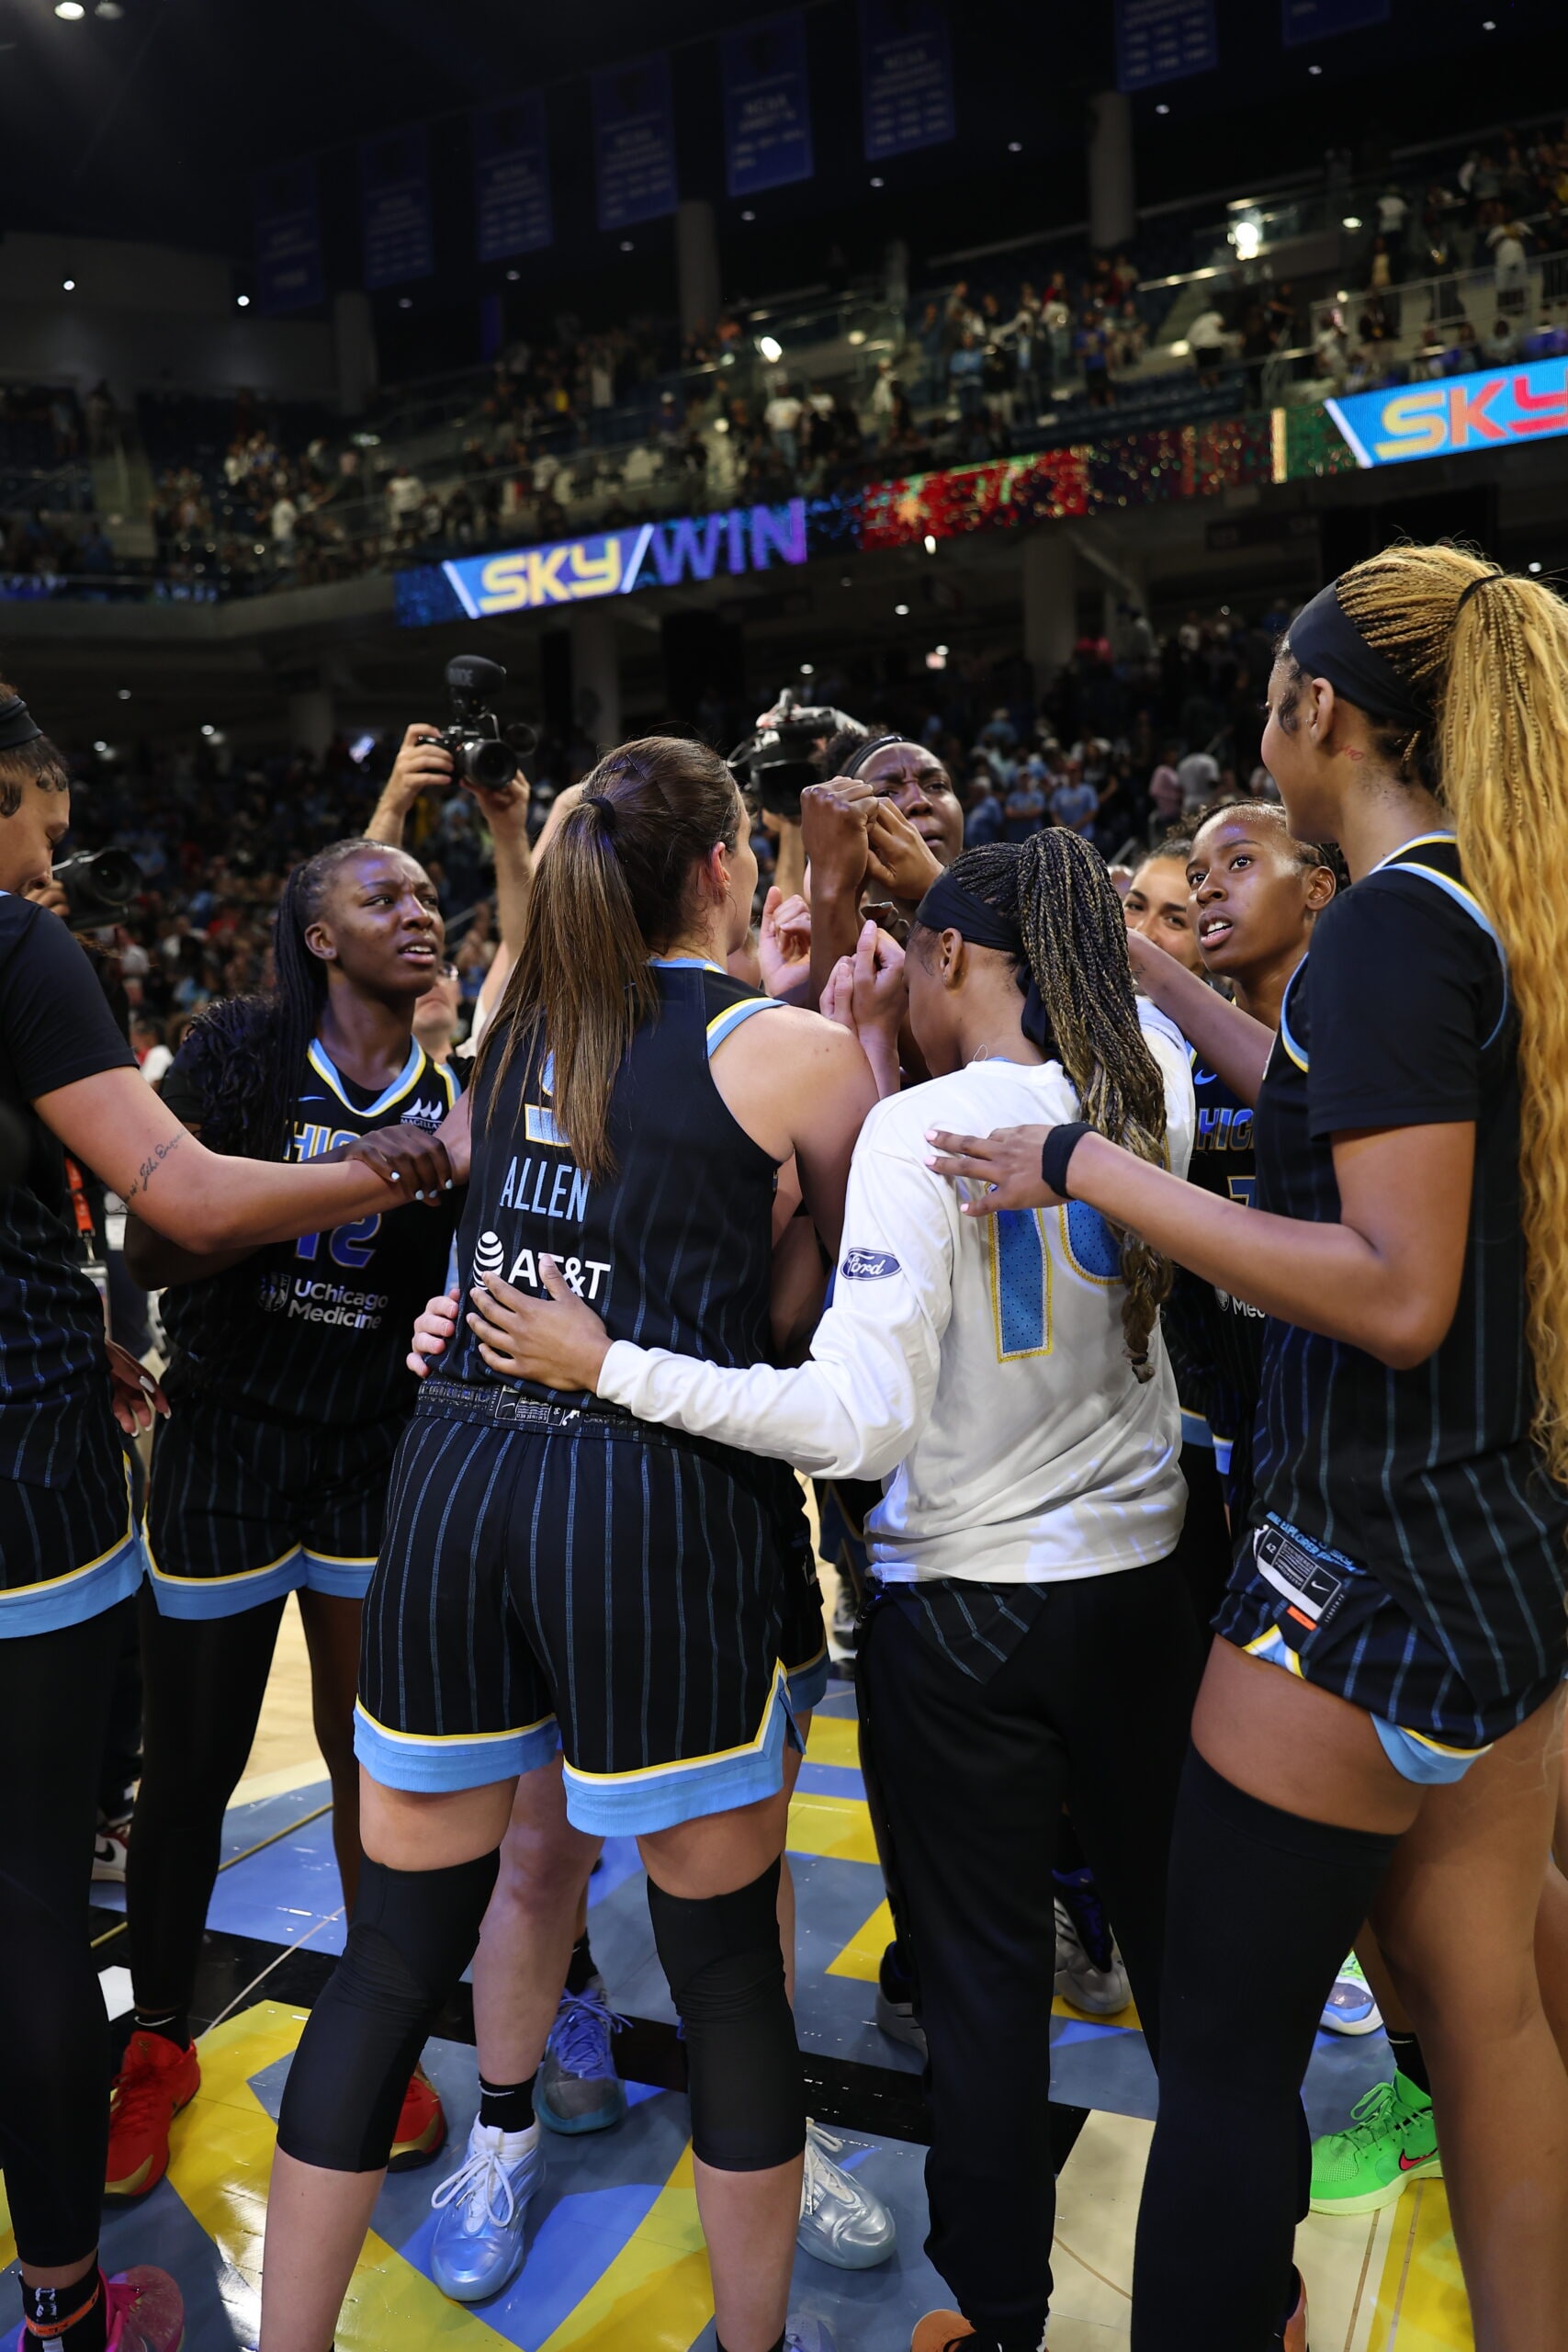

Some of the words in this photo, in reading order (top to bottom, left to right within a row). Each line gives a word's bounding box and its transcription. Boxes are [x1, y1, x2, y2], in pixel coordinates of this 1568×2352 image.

[1375, 368, 1568, 460] SKY
[478, 537, 624, 614] SKY
[649, 497, 807, 586] WIN
[500, 1156, 592, 1223] ALLEN
[847, 1252, 886, 1275] Ford
[288, 1299, 382, 1329] Medicine
[294, 1278, 389, 1310] UChicago
